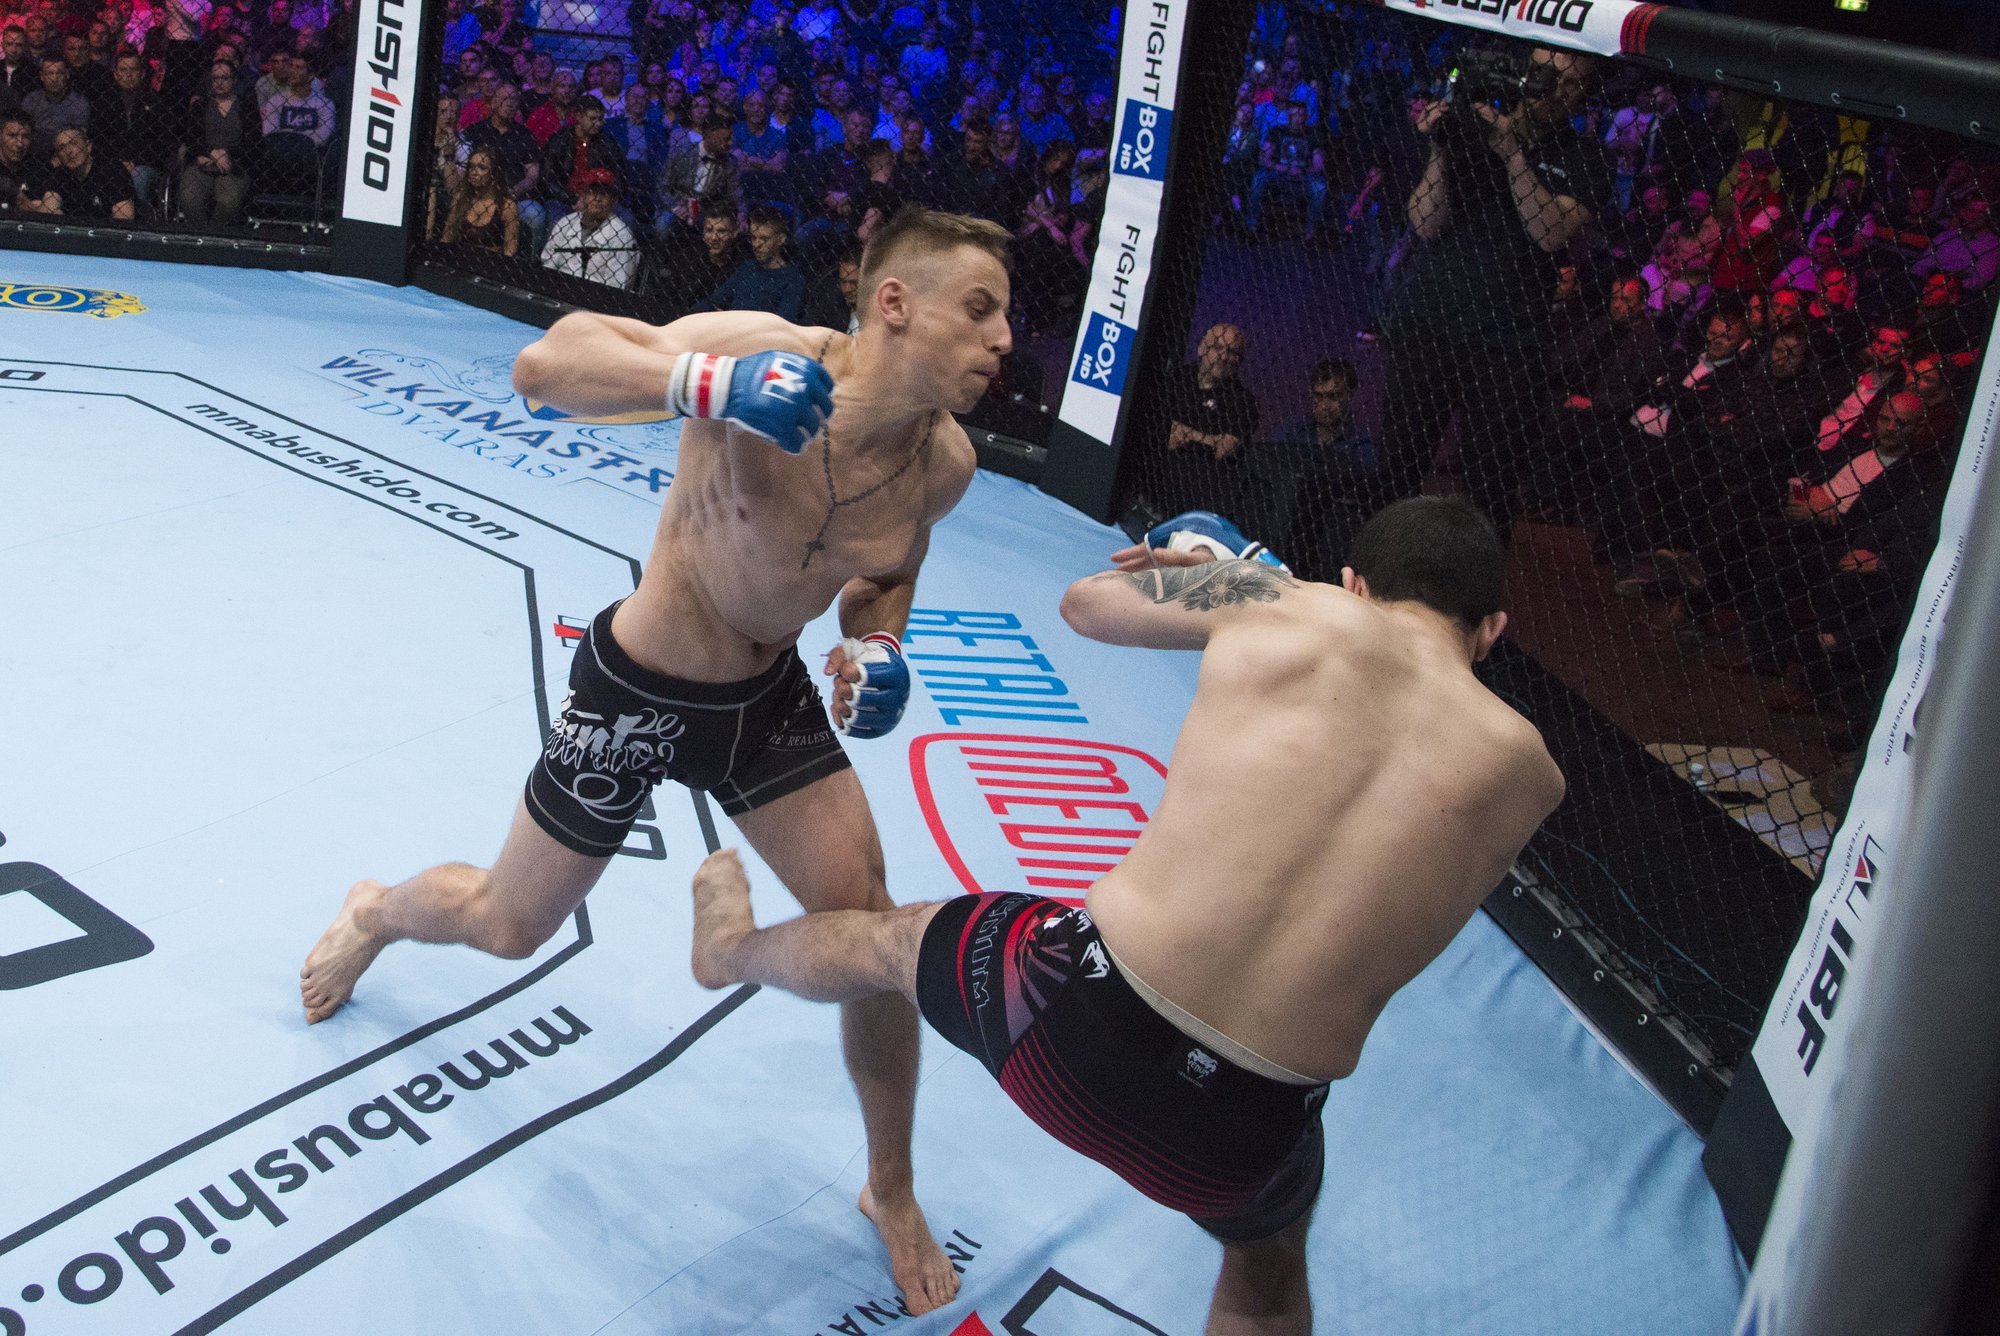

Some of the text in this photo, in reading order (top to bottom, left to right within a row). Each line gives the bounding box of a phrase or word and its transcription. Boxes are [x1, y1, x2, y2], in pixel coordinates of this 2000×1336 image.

[363, 0, 405, 192] USHIDO
[1120, 142, 1133, 171] HD
[320, 355, 675, 493] VILKANASTR
[1079, 352, 1093, 380] HD
[1972, 392, 1998, 474] FEDERATION
[185, 403, 520, 541] mmabushido.com
[355, 400, 568, 479] DVARAS
[901, 608, 1089, 726] RETAIL
[1884, 535, 1964, 766] INTERNATIONAL BUSHIDO FEDERATION
[1780, 820, 1867, 1027] INTERNATIONAL BUSHIDO FEDERATION
[1797, 916, 1856, 1077] IBF
